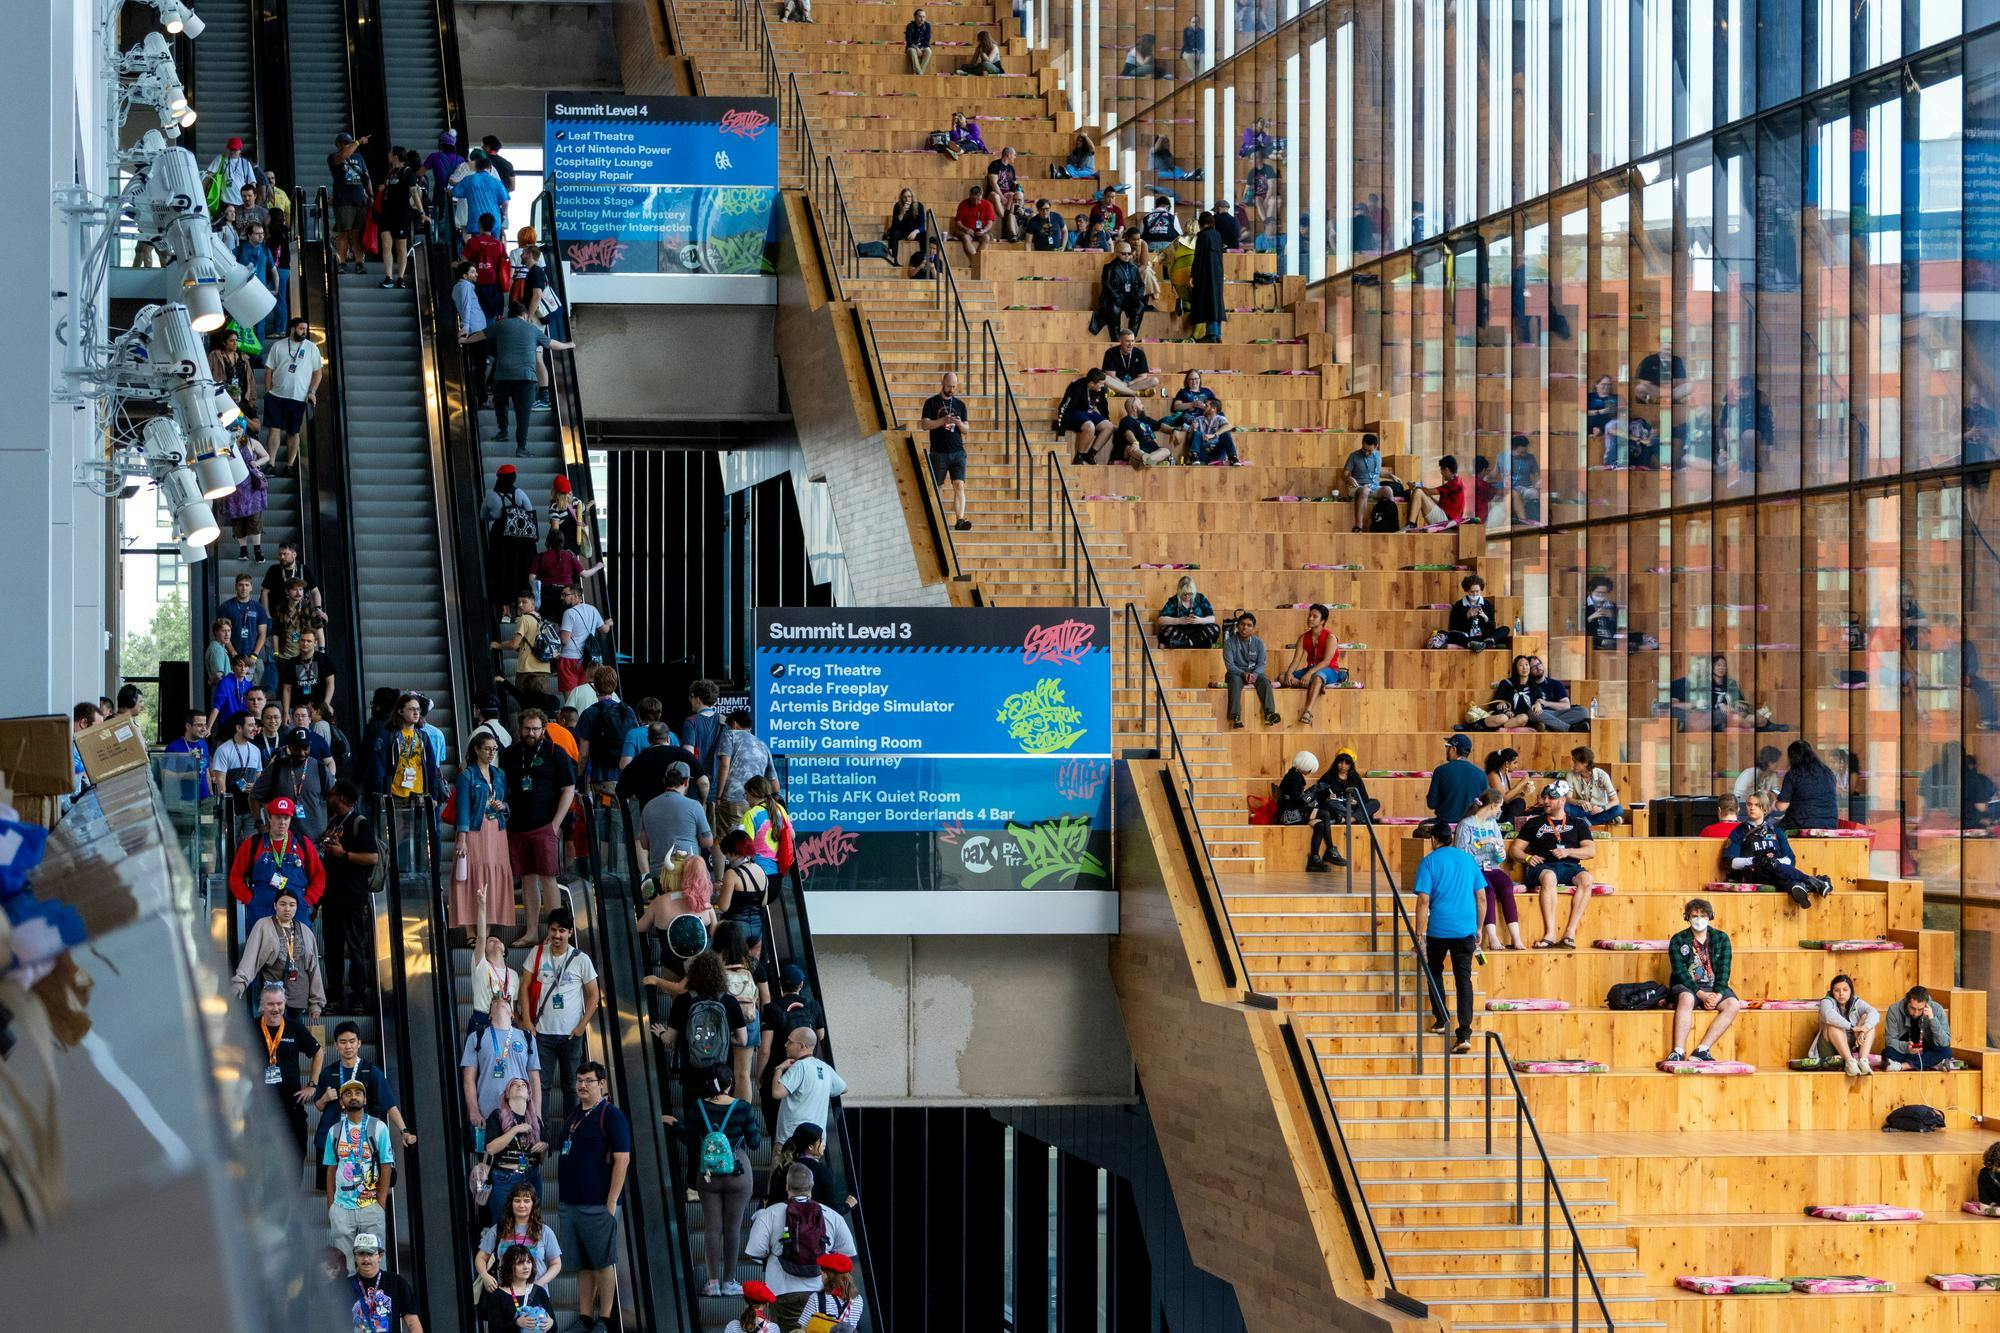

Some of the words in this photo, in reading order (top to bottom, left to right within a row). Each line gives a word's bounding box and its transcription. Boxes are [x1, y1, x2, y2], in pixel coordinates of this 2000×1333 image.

[555, 104, 604, 117] Summit
[606, 105, 638, 117] Level
[639, 105, 649, 117] 4
[568, 130, 591, 141] Leaf
[593, 131, 635, 142] Theatre
[555, 144, 573, 154] Art
[574, 144, 586, 154] of
[588, 144, 636, 155] Nintendo
[638, 145, 671, 156] Power
[555, 156, 612, 169] Cospitality
[614, 157, 654, 170] Lounge
[555, 169, 597, 182] Cosplay
[599, 170, 634, 182] Repair
[555, 195, 601, 206] Jackbox
[603, 197, 634, 208] Stage
[555, 208, 600, 220] Foulplay
[602, 209, 641, 220] Murder
[642, 210, 686, 222] Mystery
[555, 222, 578, 232] PAX
[580, 223, 626, 235] Together
[628, 223, 693, 234] Intersection
[769, 621, 845, 640] Summit
[848, 621, 896, 640] Level
[899, 622, 912, 640] 3
[787, 663, 821, 679] Frog
[824, 663, 882, 677] Theatre
[769, 681, 823, 695] Arcade
[826, 681, 889, 697] Freeplay
[714, 696, 749, 706] UMMIT
[769, 699, 829, 713] Artemis
[832, 699, 880, 716] Bridge
[883, 699, 955, 713] Simulator
[712, 705, 751, 714] DIRECTO
[769, 717, 817, 731] Merch
[819, 717, 860, 731] Store
[769, 735, 818, 752] Family
[820, 735, 878, 752] Gaming
[880, 736, 922, 749] Room
[789, 756, 839, 767] ndheld
[788, 773, 808, 785] eel
[811, 773, 877, 785] Battalion
[788, 790, 805, 804] ke
[807, 790, 839, 804] This
[842, 791, 873, 804] AFK
[876, 790, 916, 805] Quiet
[918, 791, 961, 803] Room
[791, 808, 826, 822] odoo
[829, 808, 882, 824] Ranger
[885, 808, 974, 822] Borderlands
[977, 808, 987, 821] 4
[989, 808, 1015, 821] Bar
[1002, 842, 1021, 854] PA
[1753, 840, 1776, 851] R.PD.
